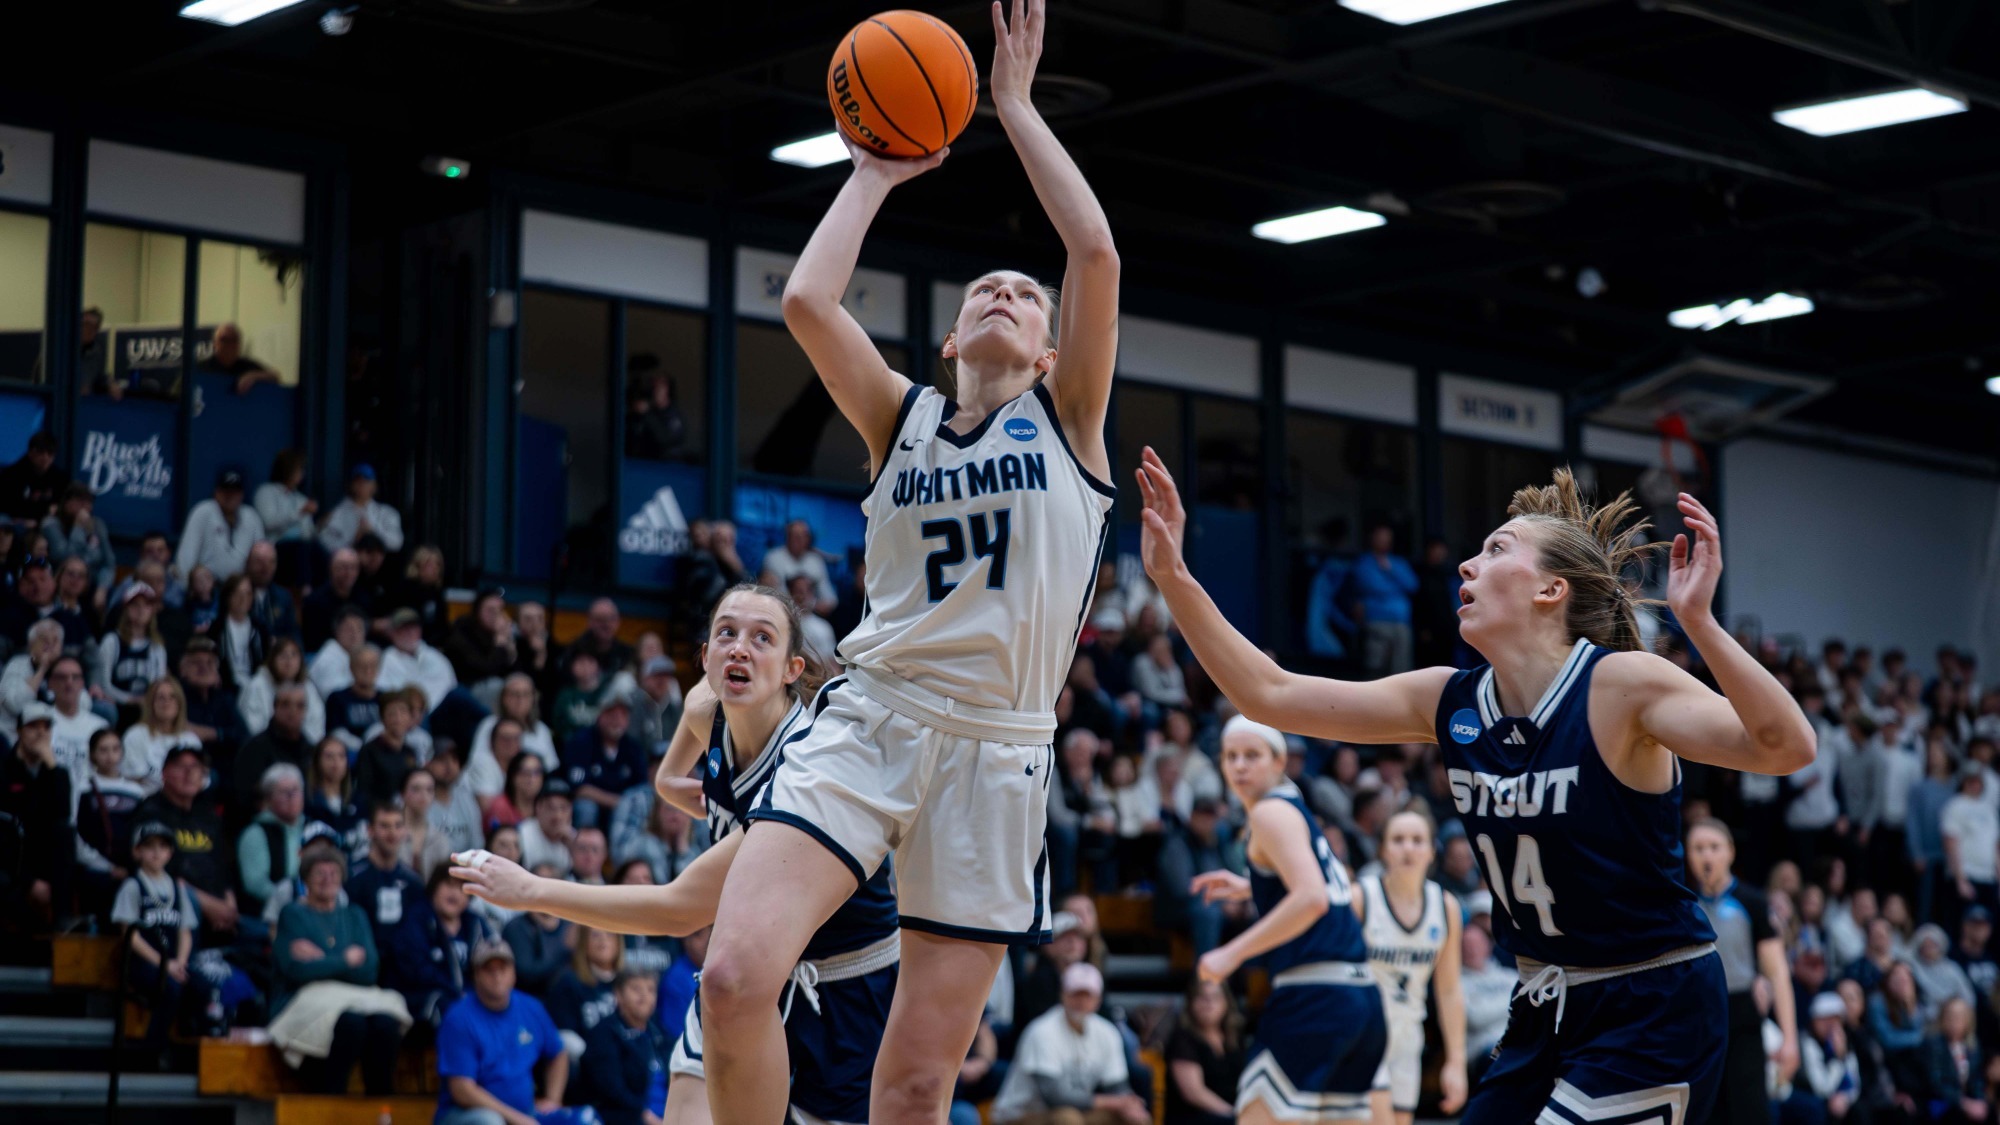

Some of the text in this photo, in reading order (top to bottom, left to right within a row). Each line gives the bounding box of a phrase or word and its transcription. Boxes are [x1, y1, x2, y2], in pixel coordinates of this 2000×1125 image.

[832, 58, 890, 150] Wilson
[1009, 428, 1036, 436] NCAA
[892, 452, 1048, 508] WHITMAN
[619, 528, 690, 555] adida
[921, 507, 1012, 604] 24
[1453, 723, 1480, 737] NCAA
[1448, 765, 1580, 818] STOUT
[1476, 833, 1566, 937] 14
